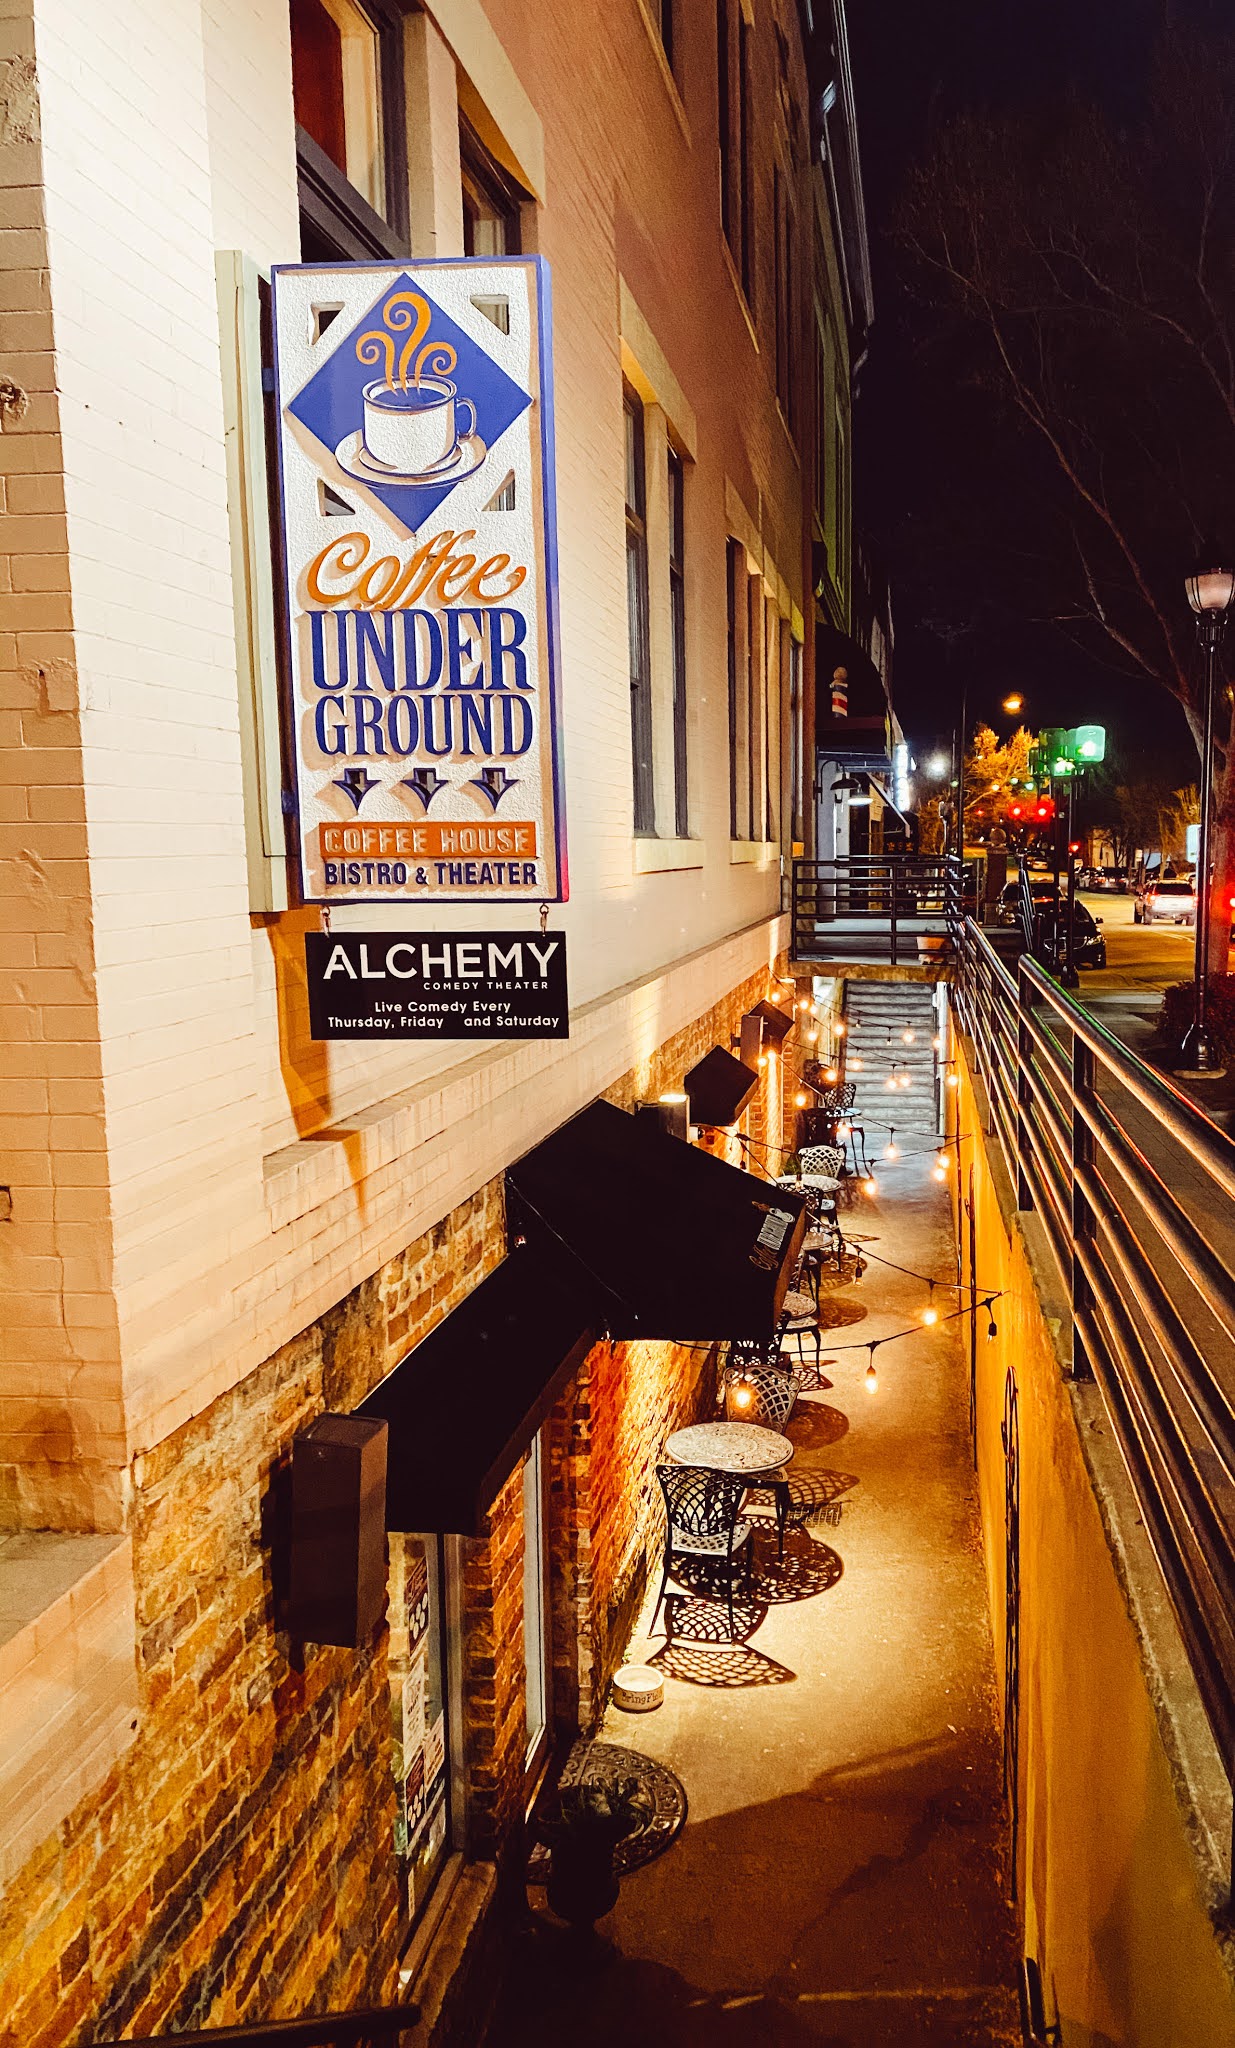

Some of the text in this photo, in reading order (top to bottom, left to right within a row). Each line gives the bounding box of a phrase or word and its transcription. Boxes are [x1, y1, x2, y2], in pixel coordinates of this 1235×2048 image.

[307, 529, 526, 611] Coffee
[306, 607, 536, 691] UNDER
[314, 693, 533, 756] GROUND
[324, 827, 529, 853] COFFEE HOUSE
[324, 862, 537, 885] BISTRO & THEATER
[323, 942, 559, 980] ALCHEMY
[423, 981, 548, 990] COMEDY THEATER
[374, 1001, 511, 1014] Live Comedy Every
[328, 1015, 559, 1029] Thursday, Friday and Saturday
